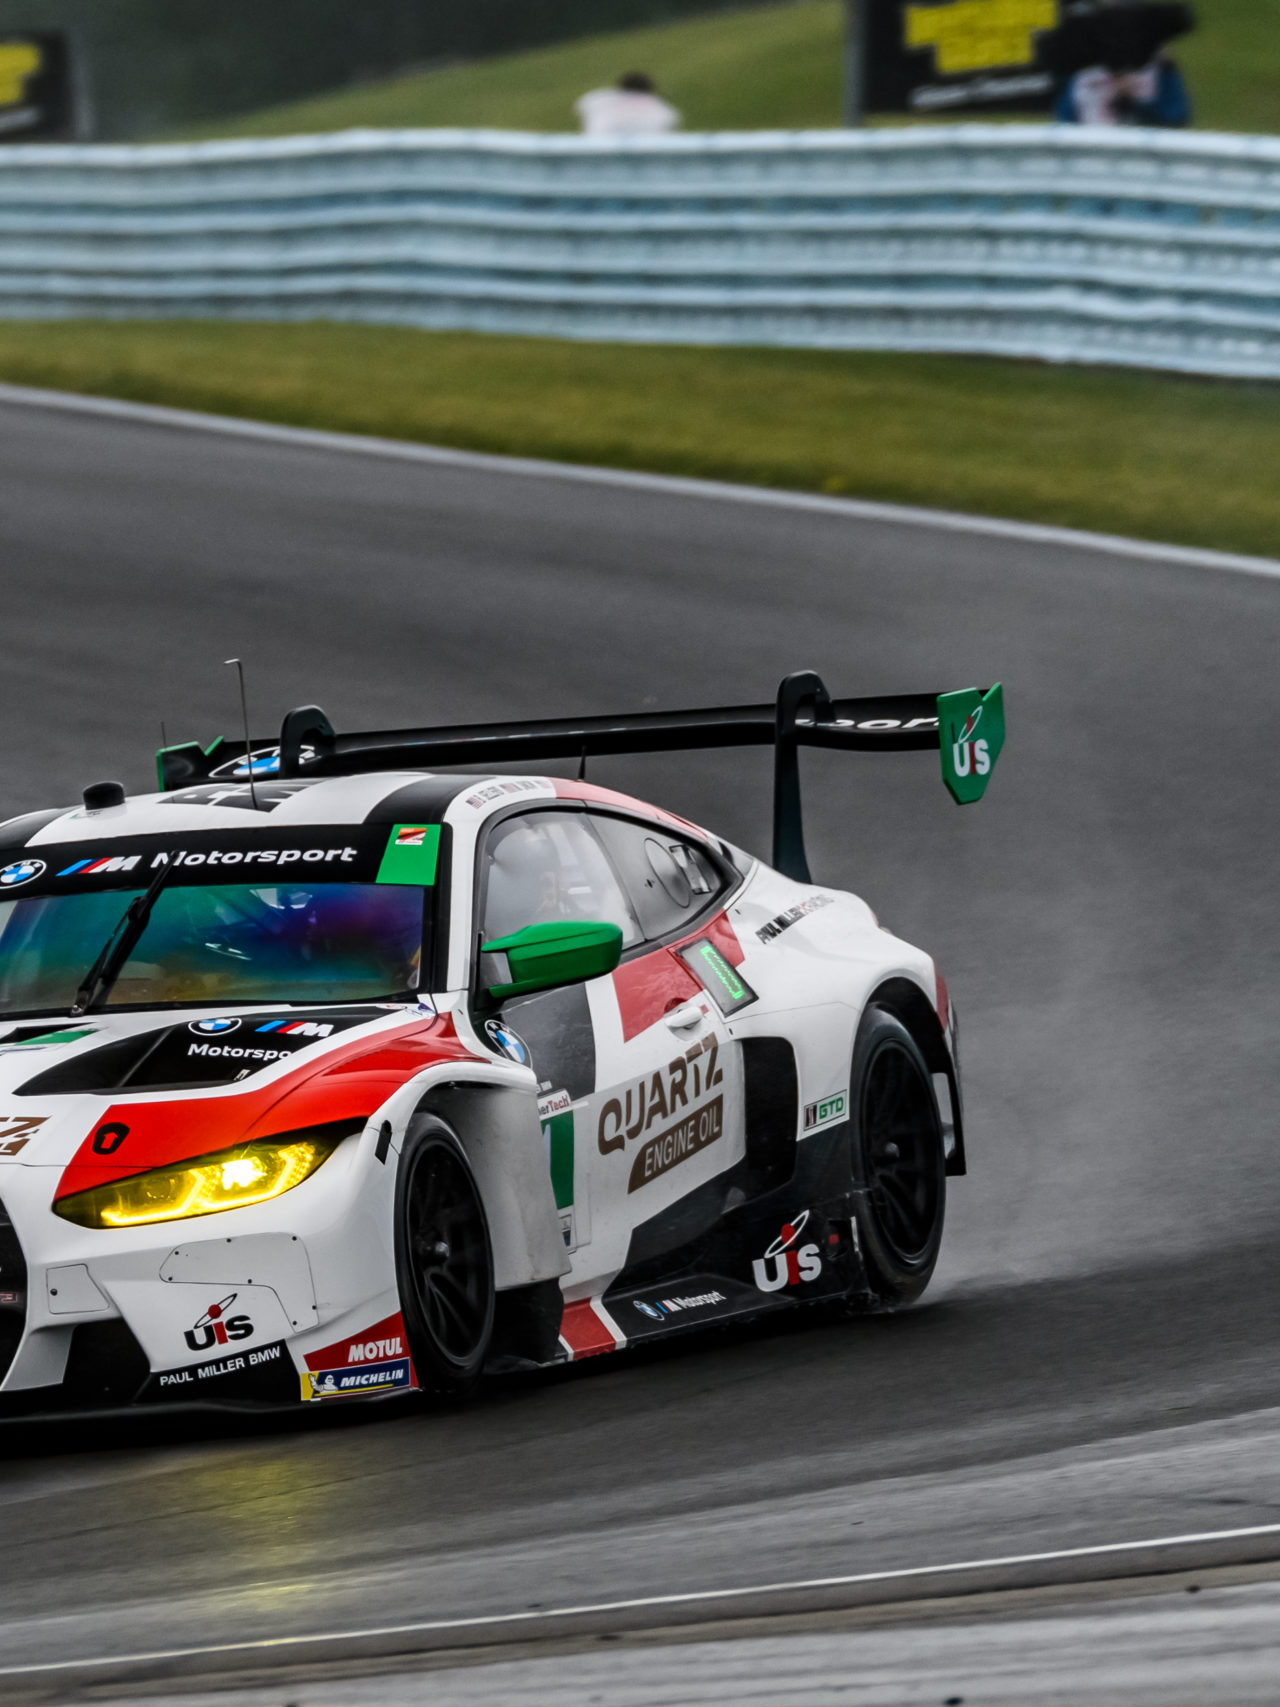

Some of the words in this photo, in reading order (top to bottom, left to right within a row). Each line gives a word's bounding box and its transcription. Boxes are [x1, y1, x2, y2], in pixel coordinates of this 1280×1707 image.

[150, 847, 357, 868] Motorsport
[598, 1032, 723, 1155] QUARTZ
[819, 1096, 844, 1119] GTD
[645, 1119, 695, 1177] ENGINE
[699, 1105, 720, 1142] OIL
[348, 1337, 403, 1363] MOTUL
[160, 1370, 194, 1386] PAUL
[197, 1357, 246, 1379] MILLER
[249, 1346, 281, 1366] BMW
[340, 1368, 404, 1387] MICHELIN
